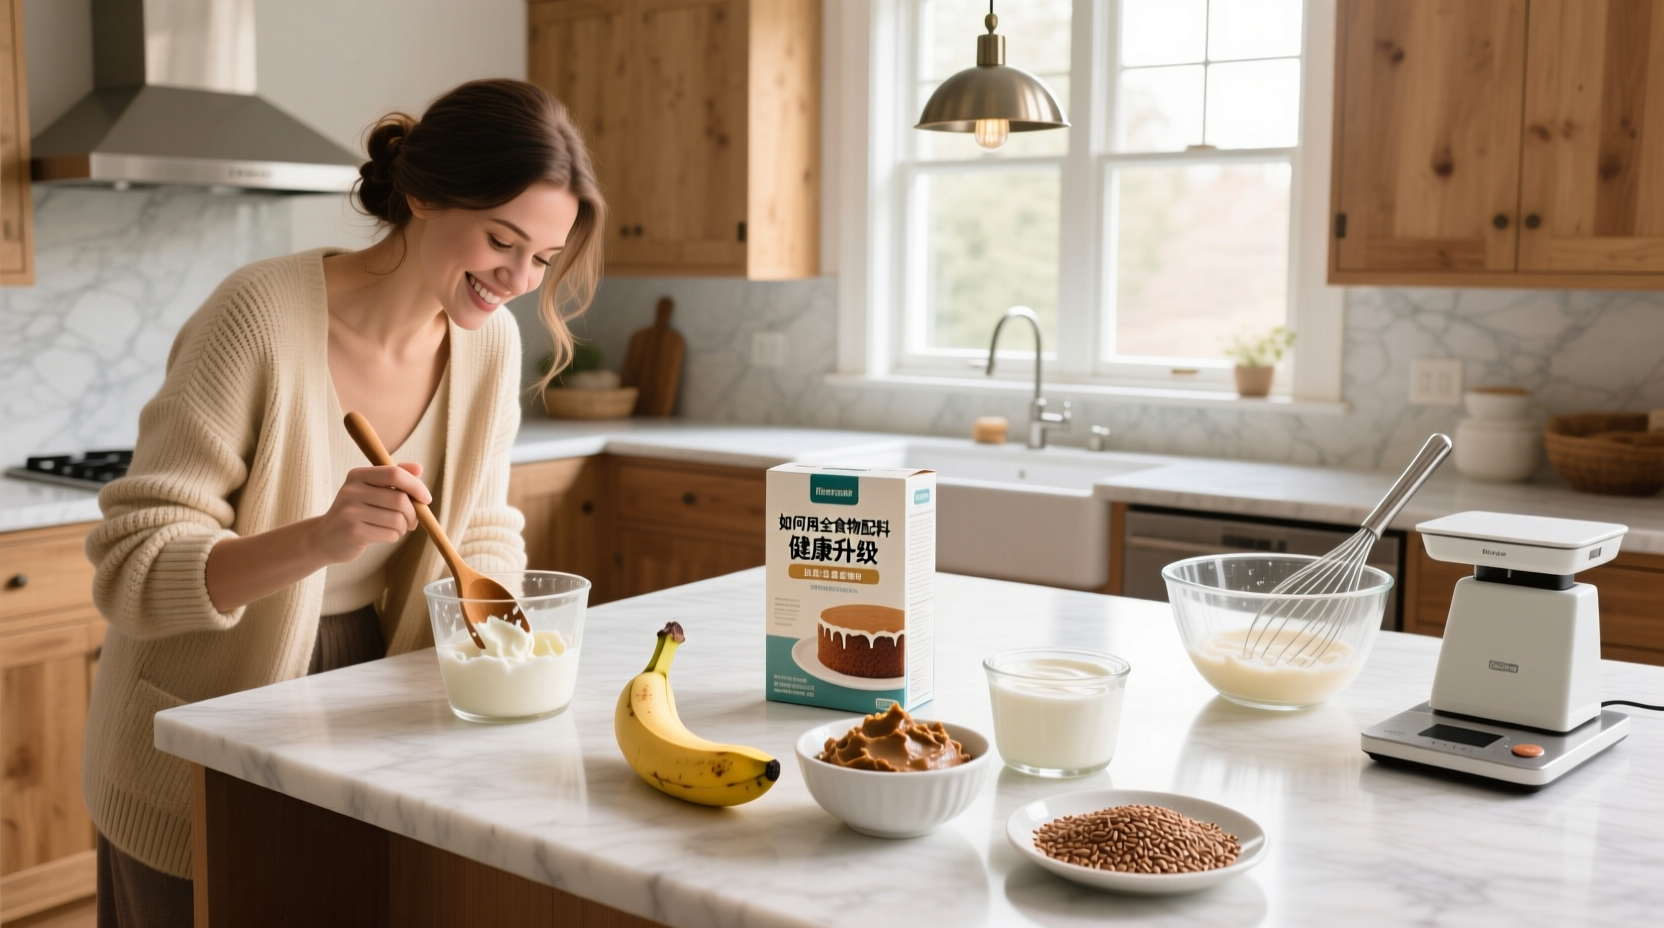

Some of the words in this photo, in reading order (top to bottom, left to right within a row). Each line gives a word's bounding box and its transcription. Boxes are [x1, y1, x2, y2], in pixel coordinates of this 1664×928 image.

[778, 513, 890, 538] 如何用全食物配料
[789, 534, 878, 565] 健康升级
